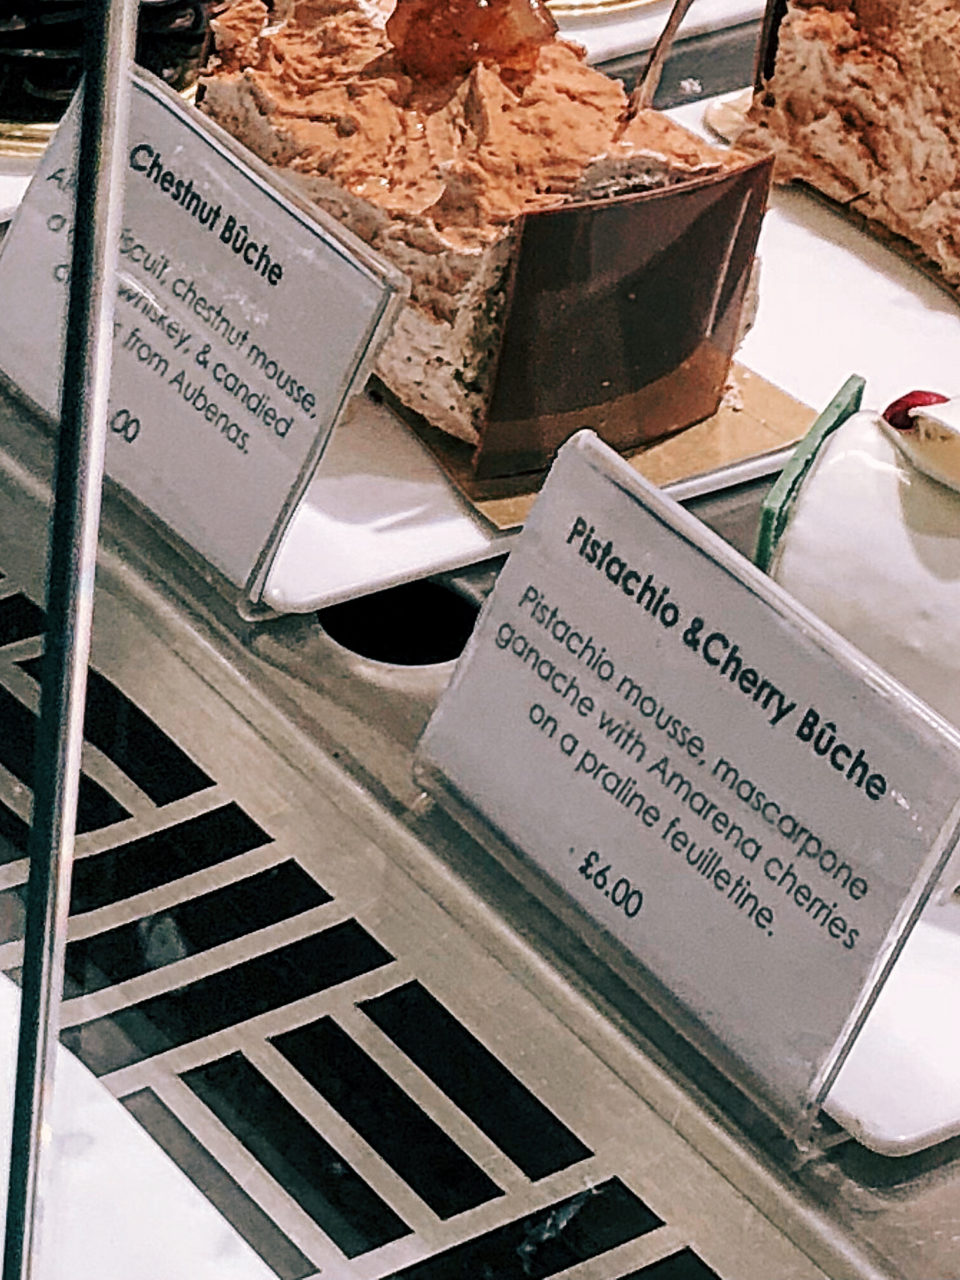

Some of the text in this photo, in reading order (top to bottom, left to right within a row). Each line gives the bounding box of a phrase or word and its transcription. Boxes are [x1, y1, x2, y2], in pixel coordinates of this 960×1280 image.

[129, 144, 284, 286] Chestnut Bûche
[117, 285, 191, 354] whiskey,
[195, 343, 213, 370] &
[213, 363, 295, 439] candied
[119, 228, 166, 286] iscuit,
[172, 277, 249, 347] chestnut
[247, 344, 318, 419] mousse,
[122, 327, 170, 377] from
[169, 370, 250, 455] Aubenas.
[518, 585, 870, 901] Pistachio mousse, mascarpone
[566, 516, 887, 802] Pistachio &Cherry Bûche
[495, 621, 861, 951] ganache with Amarena cherries
[528, 701, 776, 938] on a praline feuilletine.
[577, 850, 644, 919] £6.00
